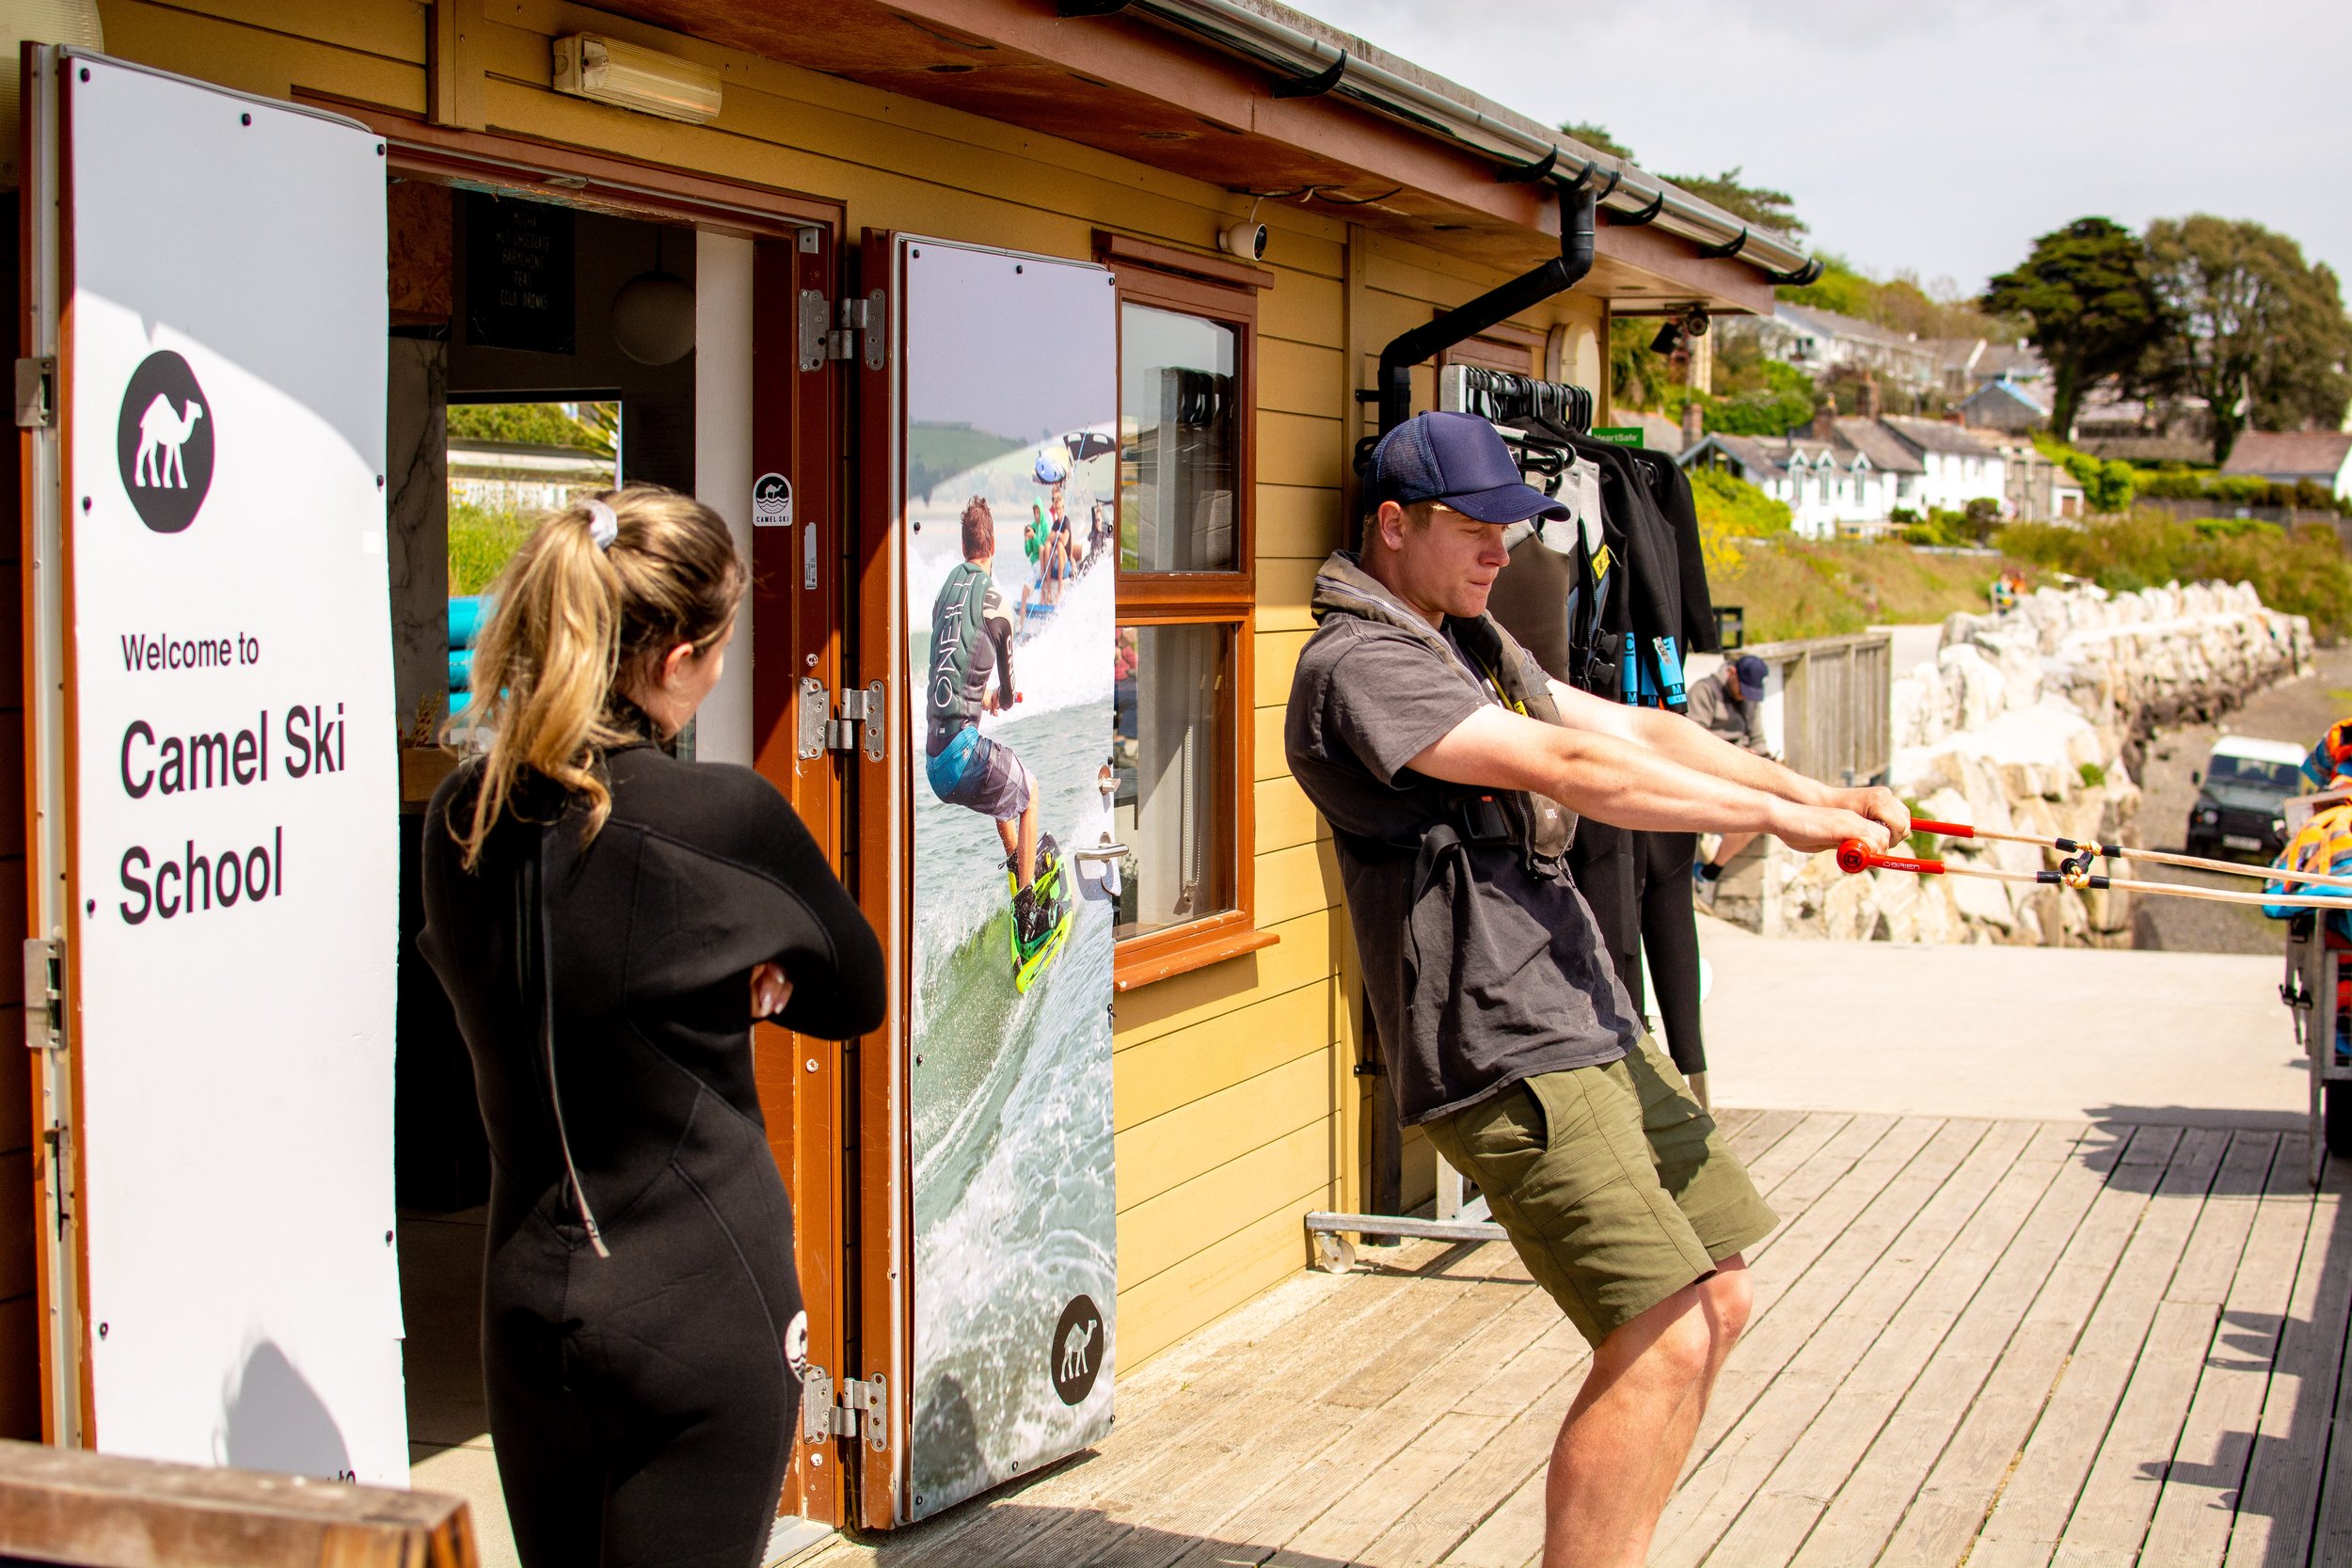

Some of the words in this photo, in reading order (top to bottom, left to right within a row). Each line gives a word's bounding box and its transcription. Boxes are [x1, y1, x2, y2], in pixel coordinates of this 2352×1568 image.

[522, 292, 549, 310] DRINKS
[121, 632, 232, 672] Welcome
[238, 631, 260, 666] to
[120, 710, 268, 800] Camel
[285, 702, 345, 779] Ski
[119, 826, 282, 926] School
